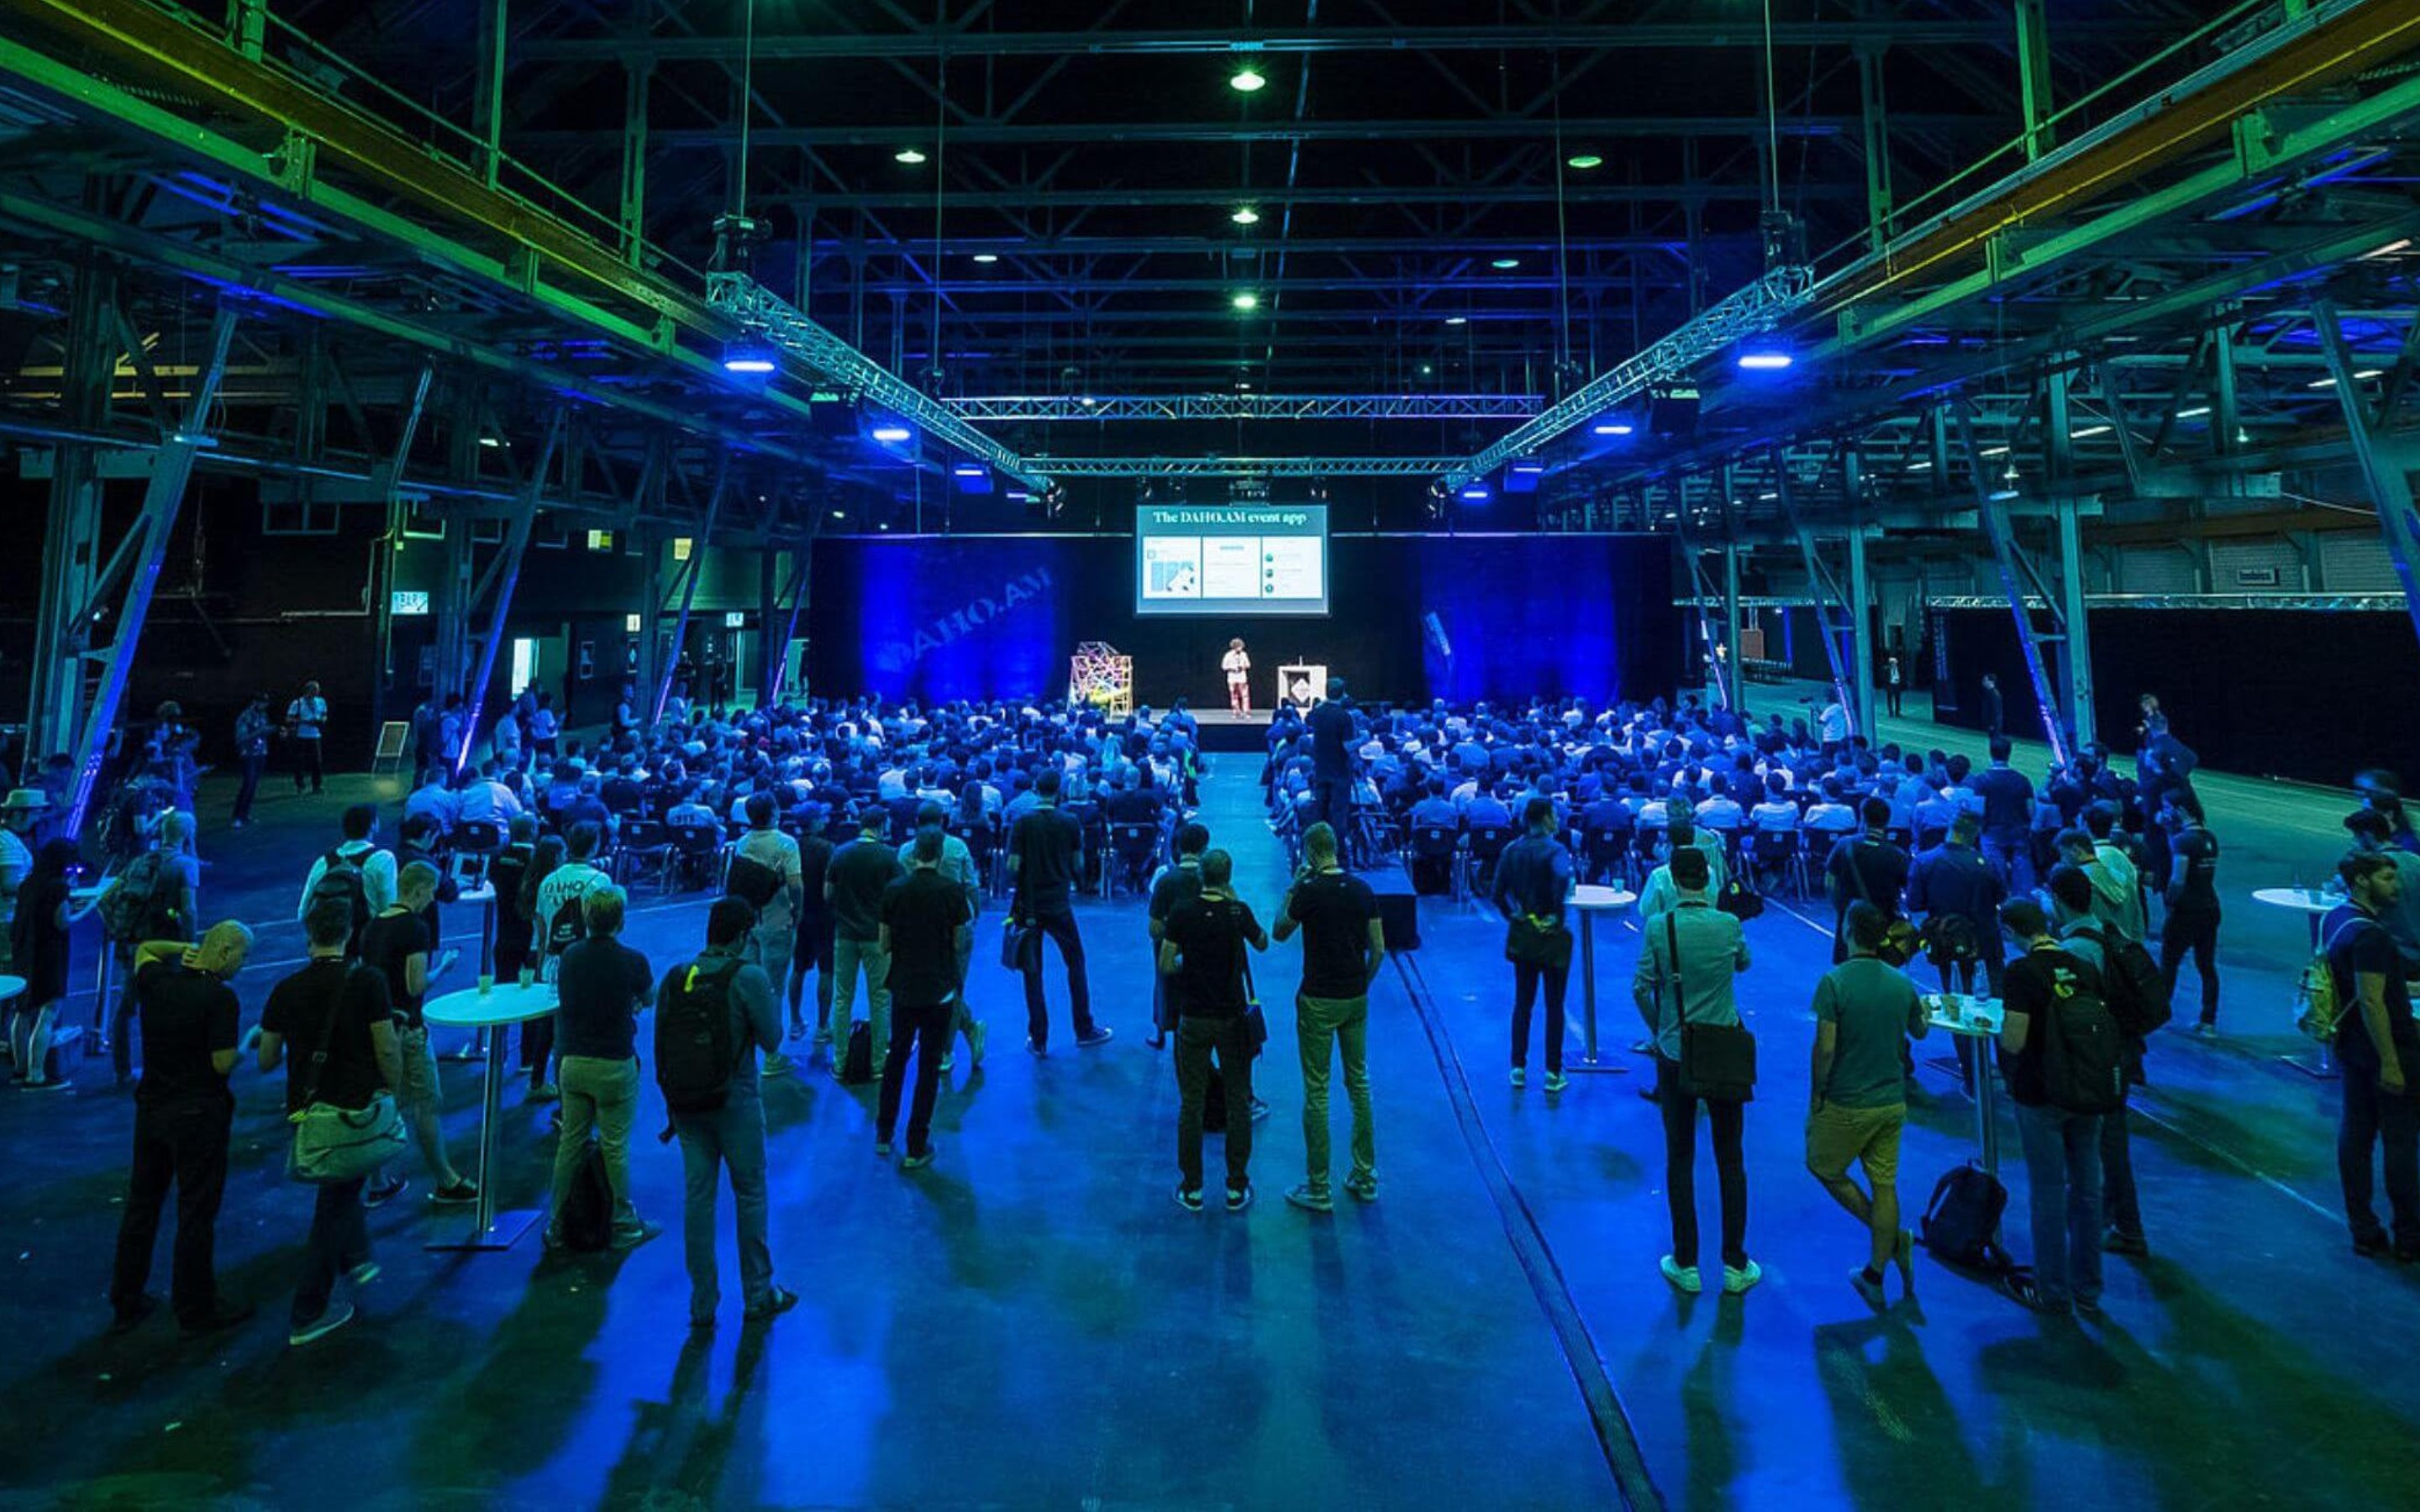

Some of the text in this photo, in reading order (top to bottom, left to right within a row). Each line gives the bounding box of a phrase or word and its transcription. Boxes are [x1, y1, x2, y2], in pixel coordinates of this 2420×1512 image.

[1153, 511, 1307, 526] The DAHO.AM event app
